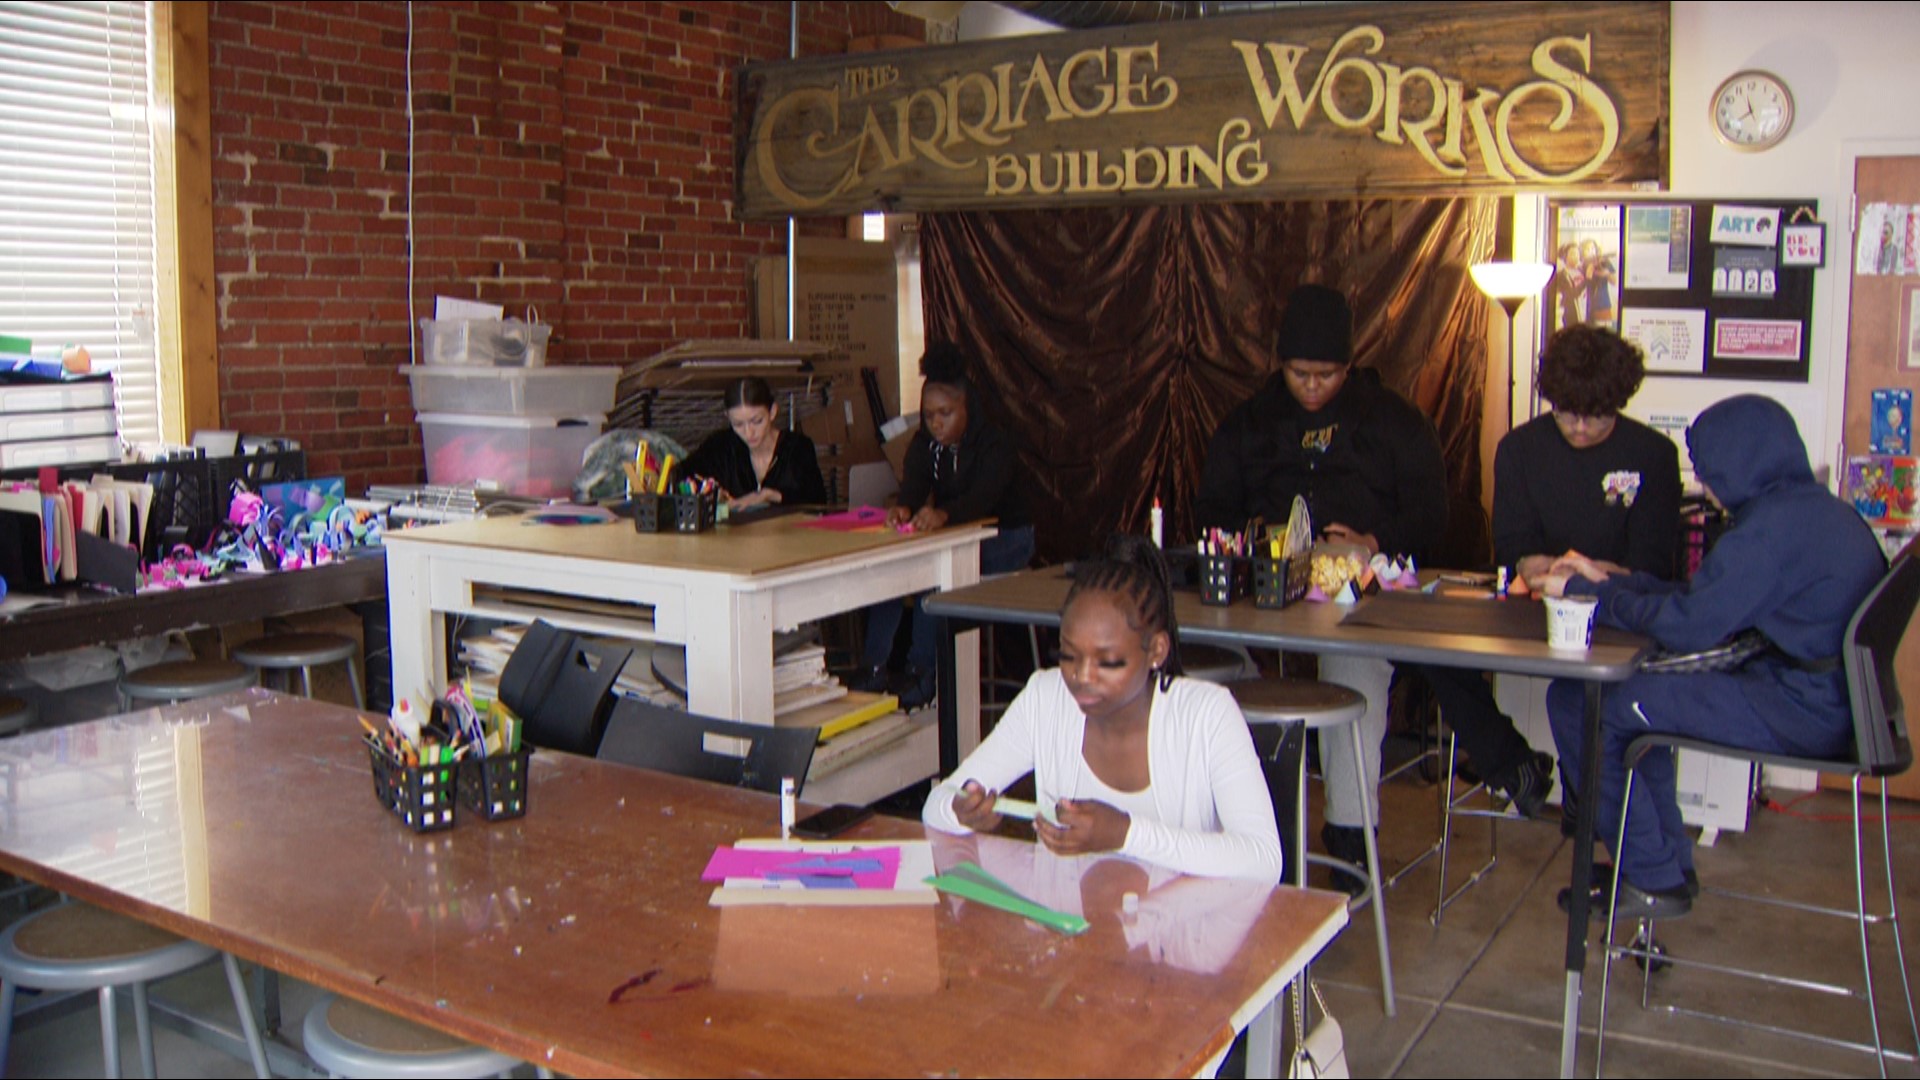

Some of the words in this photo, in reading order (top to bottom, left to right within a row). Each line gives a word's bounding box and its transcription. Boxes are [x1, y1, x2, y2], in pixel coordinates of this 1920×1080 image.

[845, 64, 899, 99] THE
[756, 40, 1178, 206] CARRIAGE
[1231, 24, 1620, 184] WORKS
[985, 118, 1269, 196] BUILDING
[1718, 215, 1755, 234] ART
